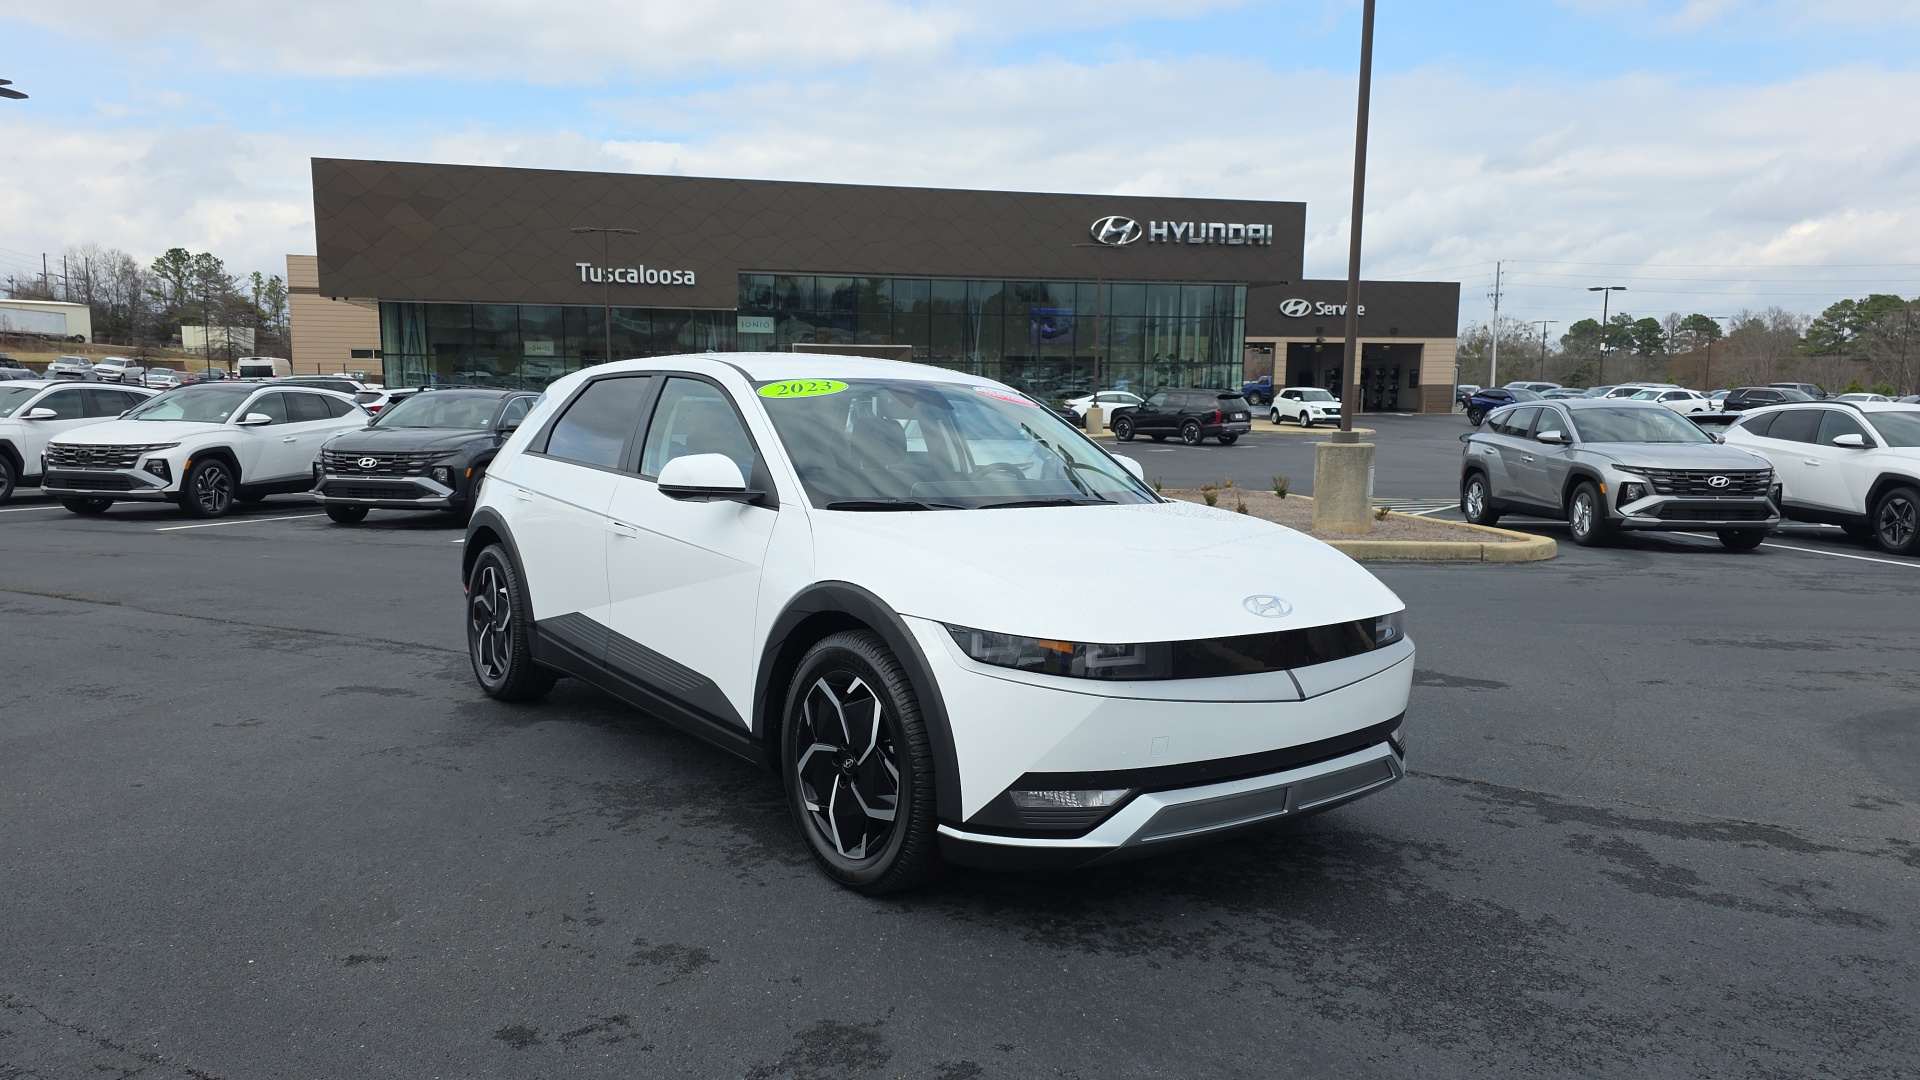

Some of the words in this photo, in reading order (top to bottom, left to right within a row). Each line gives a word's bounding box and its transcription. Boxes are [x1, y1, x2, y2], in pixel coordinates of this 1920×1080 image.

[1149, 221, 1273, 245] HYUNDAI
[576, 263, 695, 285] Tuscaloosa
[1315, 302, 1365, 316] Serve
[776, 381, 832, 396] 2023
